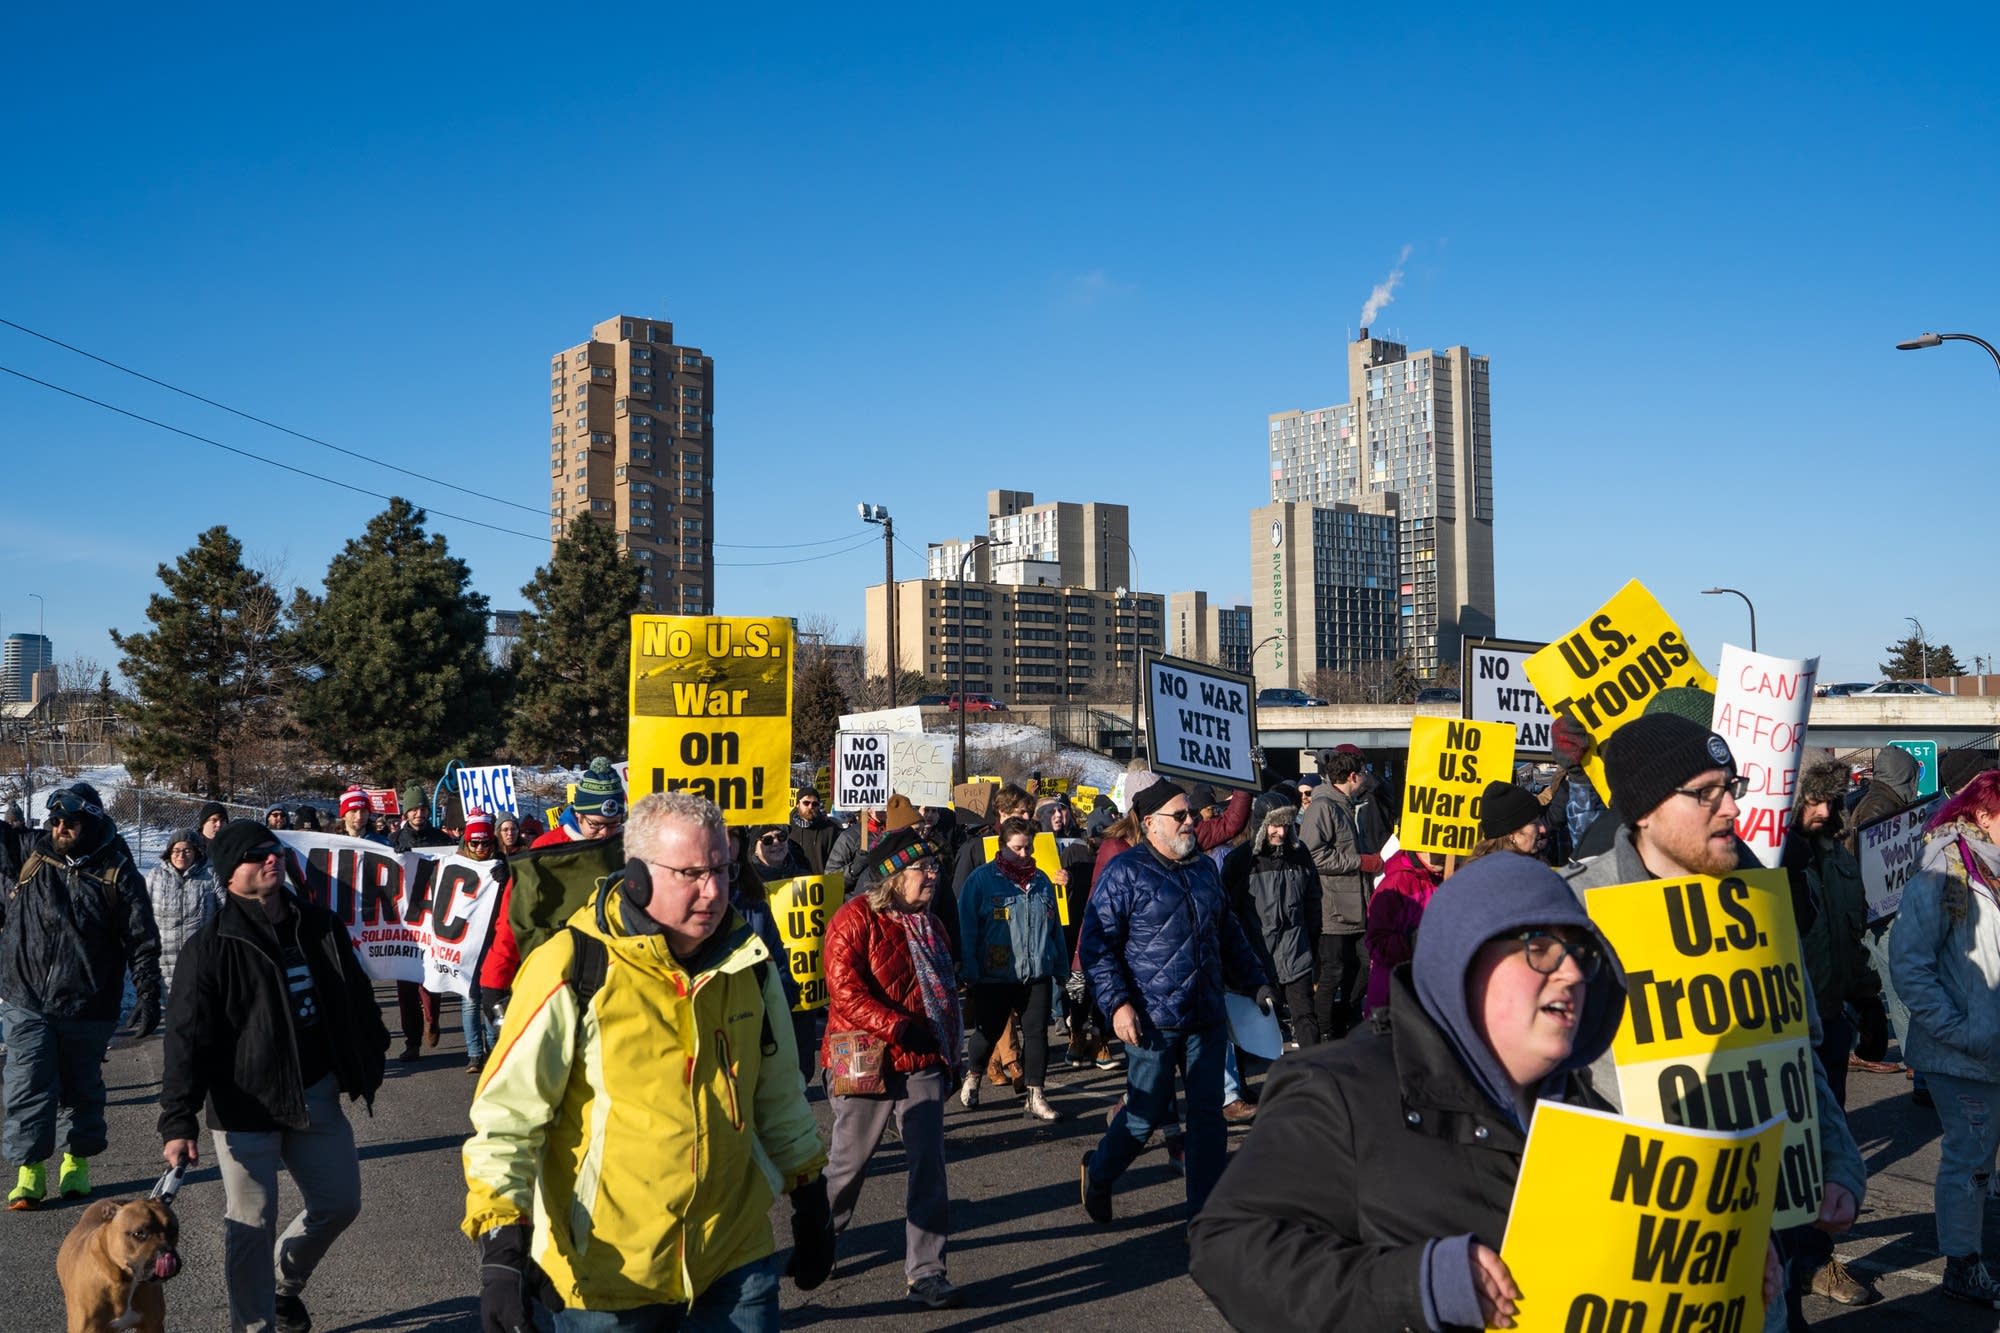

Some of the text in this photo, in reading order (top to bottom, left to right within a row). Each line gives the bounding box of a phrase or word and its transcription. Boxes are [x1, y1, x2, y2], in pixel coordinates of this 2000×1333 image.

[1273, 553, 1283, 669] RIVERSIDE PAZA
[642, 622, 781, 659] No U.S.
[1558, 614, 1637, 680] U.S.
[1479, 655, 1510, 680] NO
[1553, 630, 1689, 731] Troops
[1740, 665, 1815, 702] CAN'T
[672, 682, 749, 716] War
[1159, 671, 1244, 715] NO WAR
[1179, 709, 1231, 742] WITH
[1446, 721, 1481, 751] No
[1717, 703, 1806, 753] AFFOR
[680, 731, 740, 766] on
[852, 737, 878, 751] NO
[1179, 737, 1232, 770] IRAN
[844, 754, 886, 771] WAR
[1438, 753, 1482, 784] U.S.
[460, 768, 515, 814] PEACE
[843, 789, 885, 804] IRAN!
[851, 774, 878, 787] ON
[1409, 785, 1483, 820] War o
[1866, 815, 1901, 848] THIS
[792, 879, 824, 907] No
[1663, 877, 1768, 958] U.S.
[361, 928, 431, 946] SOLIDARIDAD
[368, 944, 425, 960] SOLIDARITY
[791, 948, 819, 975] ar
[1625, 962, 1803, 1045] Troops
[1658, 1047, 1813, 1132] Out of
[1610, 1133, 1761, 1215] No U.S.
[1632, 1214, 1743, 1285] War
[1563, 1293, 1648, 1333] on
